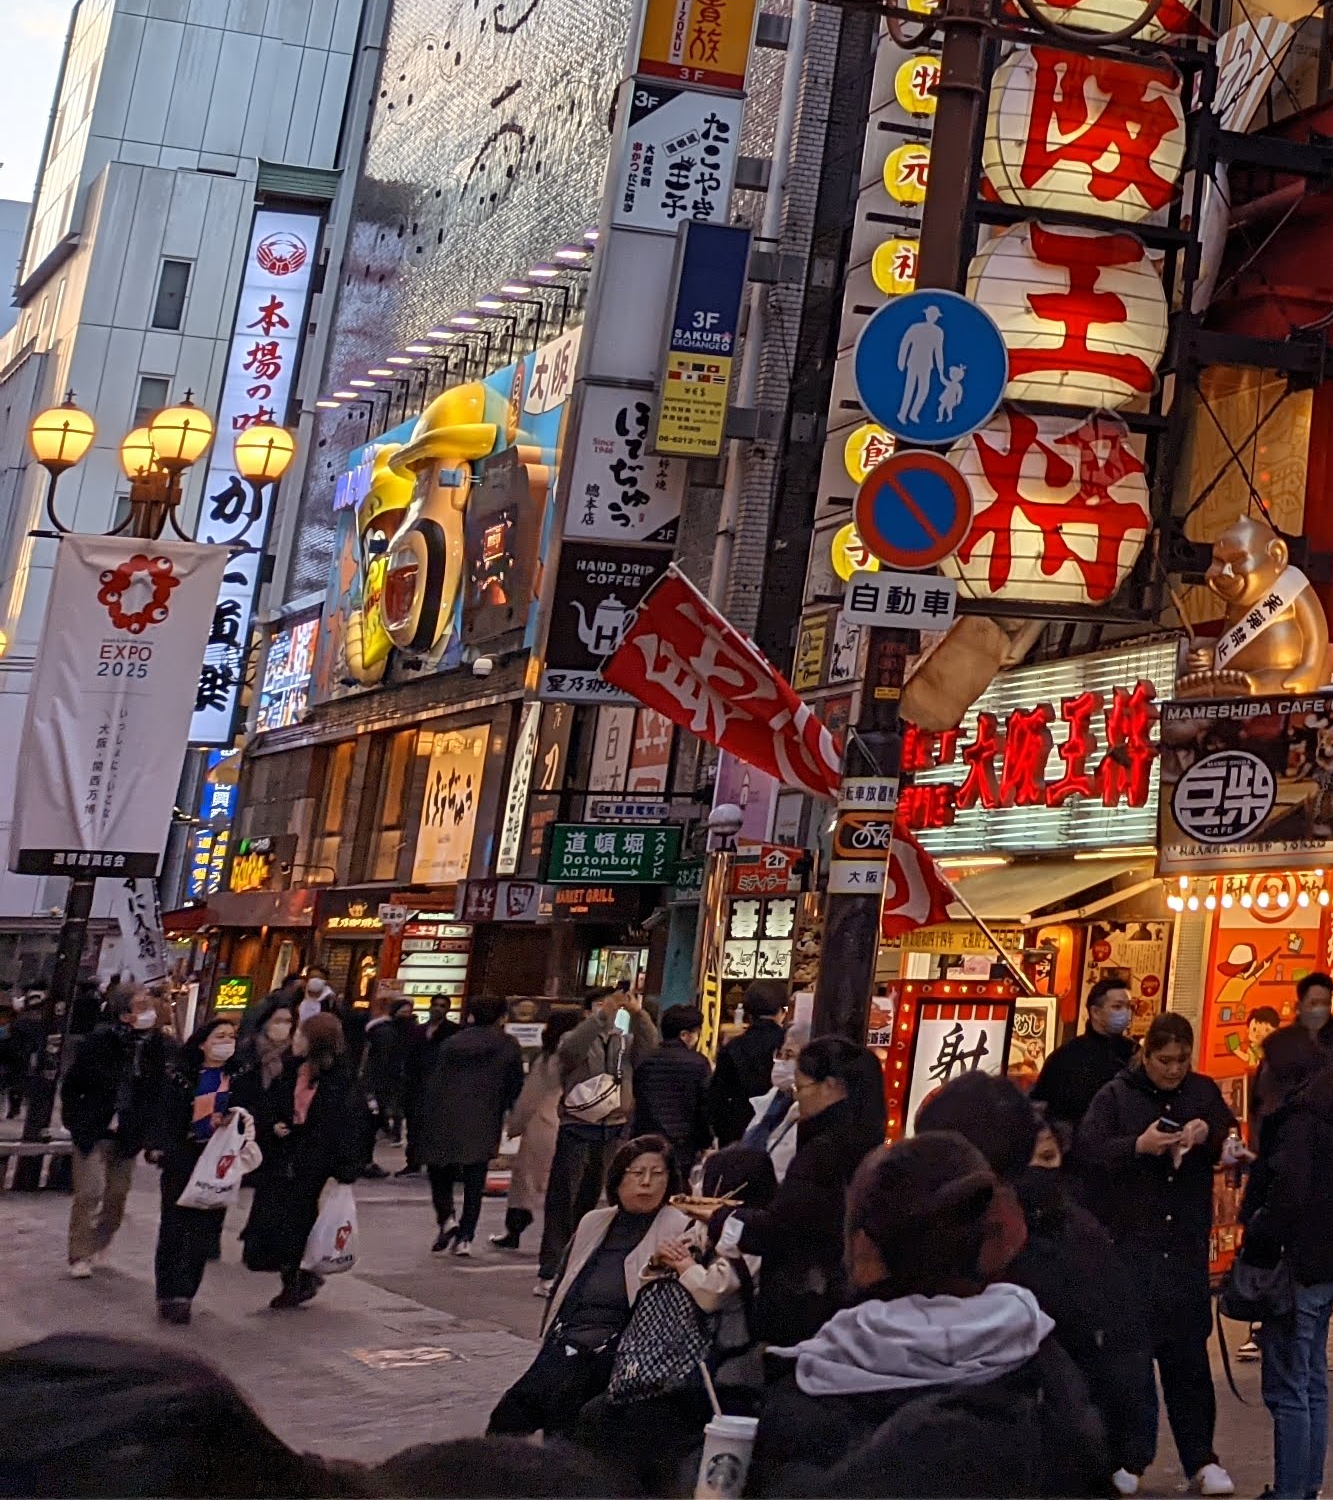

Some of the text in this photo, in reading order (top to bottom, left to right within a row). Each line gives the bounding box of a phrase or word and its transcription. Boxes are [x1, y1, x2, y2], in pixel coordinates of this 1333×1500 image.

[680, 68, 705, 82] 3F
[635, 91, 659, 108] 3F
[692, 112, 730, 220] たこやき
[661, 156, 697, 219] 王子
[692, 311, 720, 329] 3F
[673, 338, 720, 351] EXCHANGE
[674, 329, 731, 343] SAKURA
[233, 295, 288, 432] 本場の味
[531, 342, 570, 400] 大阪
[657, 528, 675, 541] 2F
[576, 560, 653, 576] HAND DRIP
[587, 573, 641, 587] COFFEE
[849, 582, 953, 619] 自動車
[100, 645, 152, 662] EXPO
[97, 662, 148, 679] 2025
[1167, 703, 1271, 721] MAMESHIBA
[1278, 699, 1325, 714] CAFE
[1205, 826, 1233, 835] CAFE
[564, 832, 645, 855] 道頓堀
[563, 854, 641, 866] Dotonbori
[652, 832, 667, 878] スタンド
[768, 855, 786, 867] 2F
[560, 866, 600, 877] 入口 2m
[738, 873, 788, 891] ミティラー
